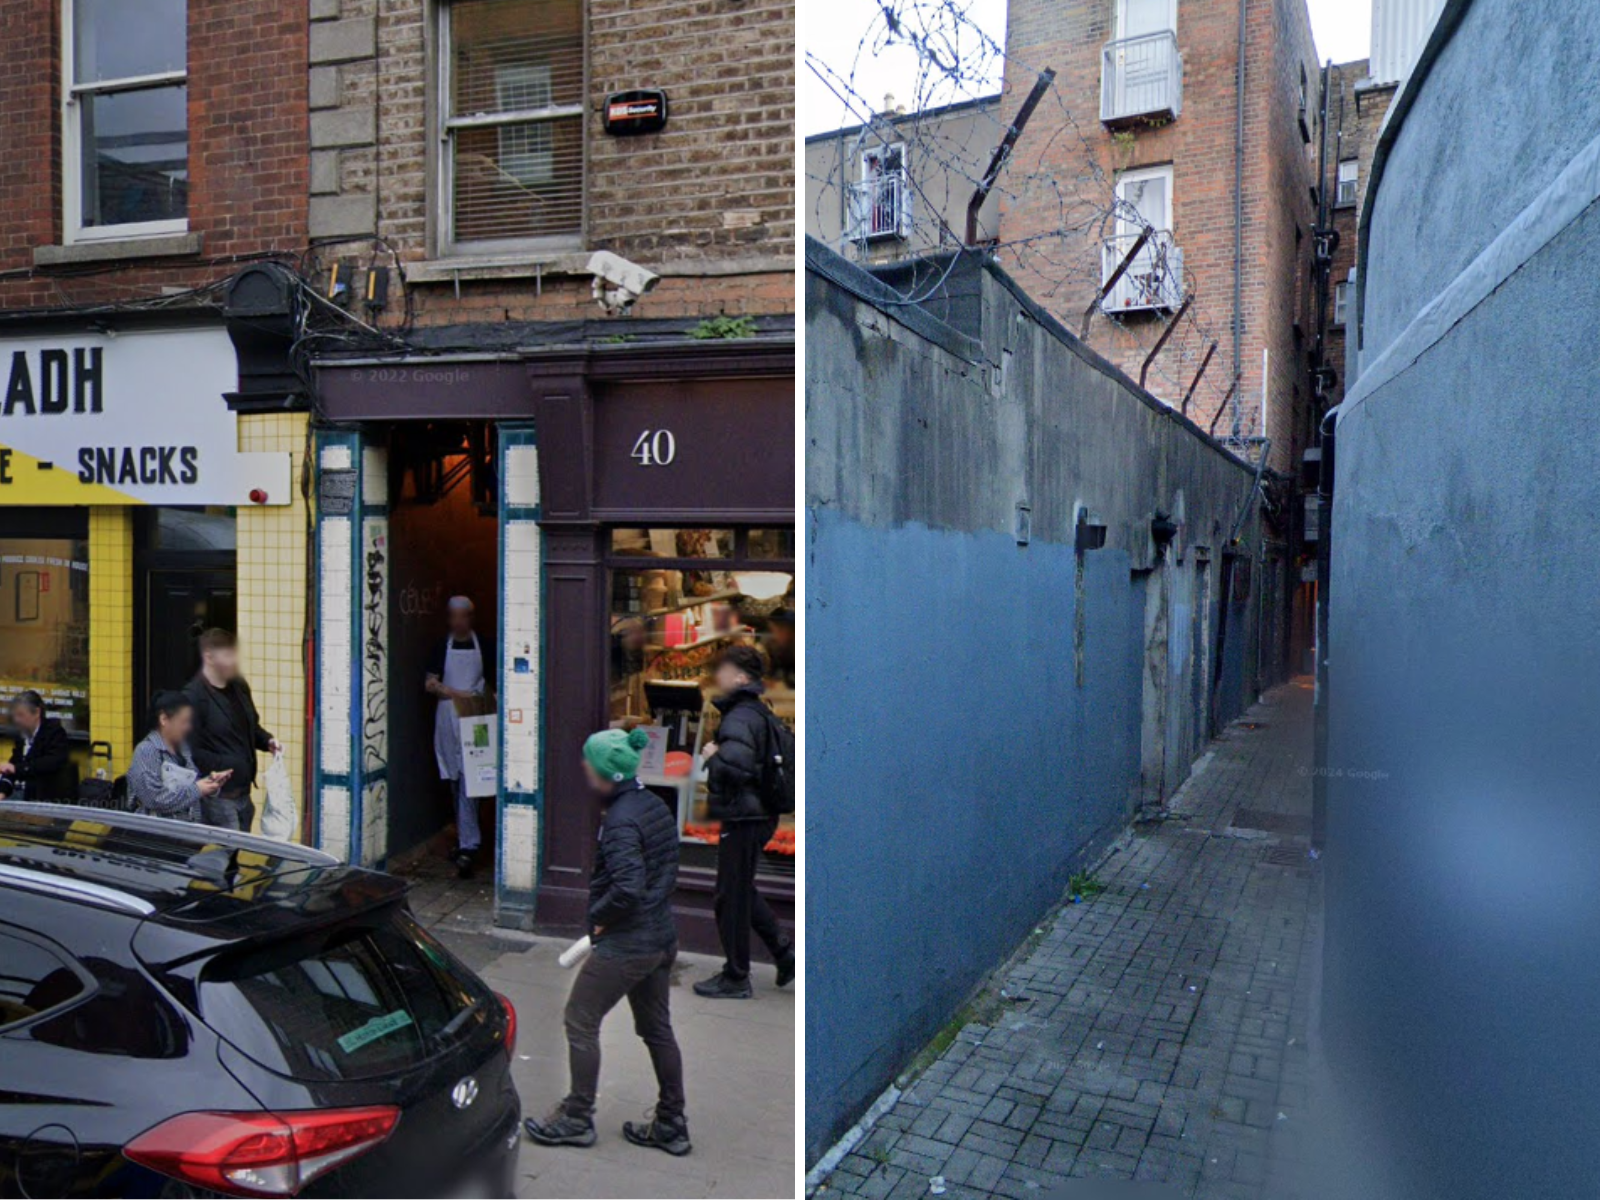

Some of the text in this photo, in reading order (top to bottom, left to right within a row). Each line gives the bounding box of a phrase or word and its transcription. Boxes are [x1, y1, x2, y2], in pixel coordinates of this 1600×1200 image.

[0, 346, 104, 416] ADH
[0, 448, 13, 484] E
[78, 446, 198, 484] SNACKS
[630, 429, 675, 465] 40
